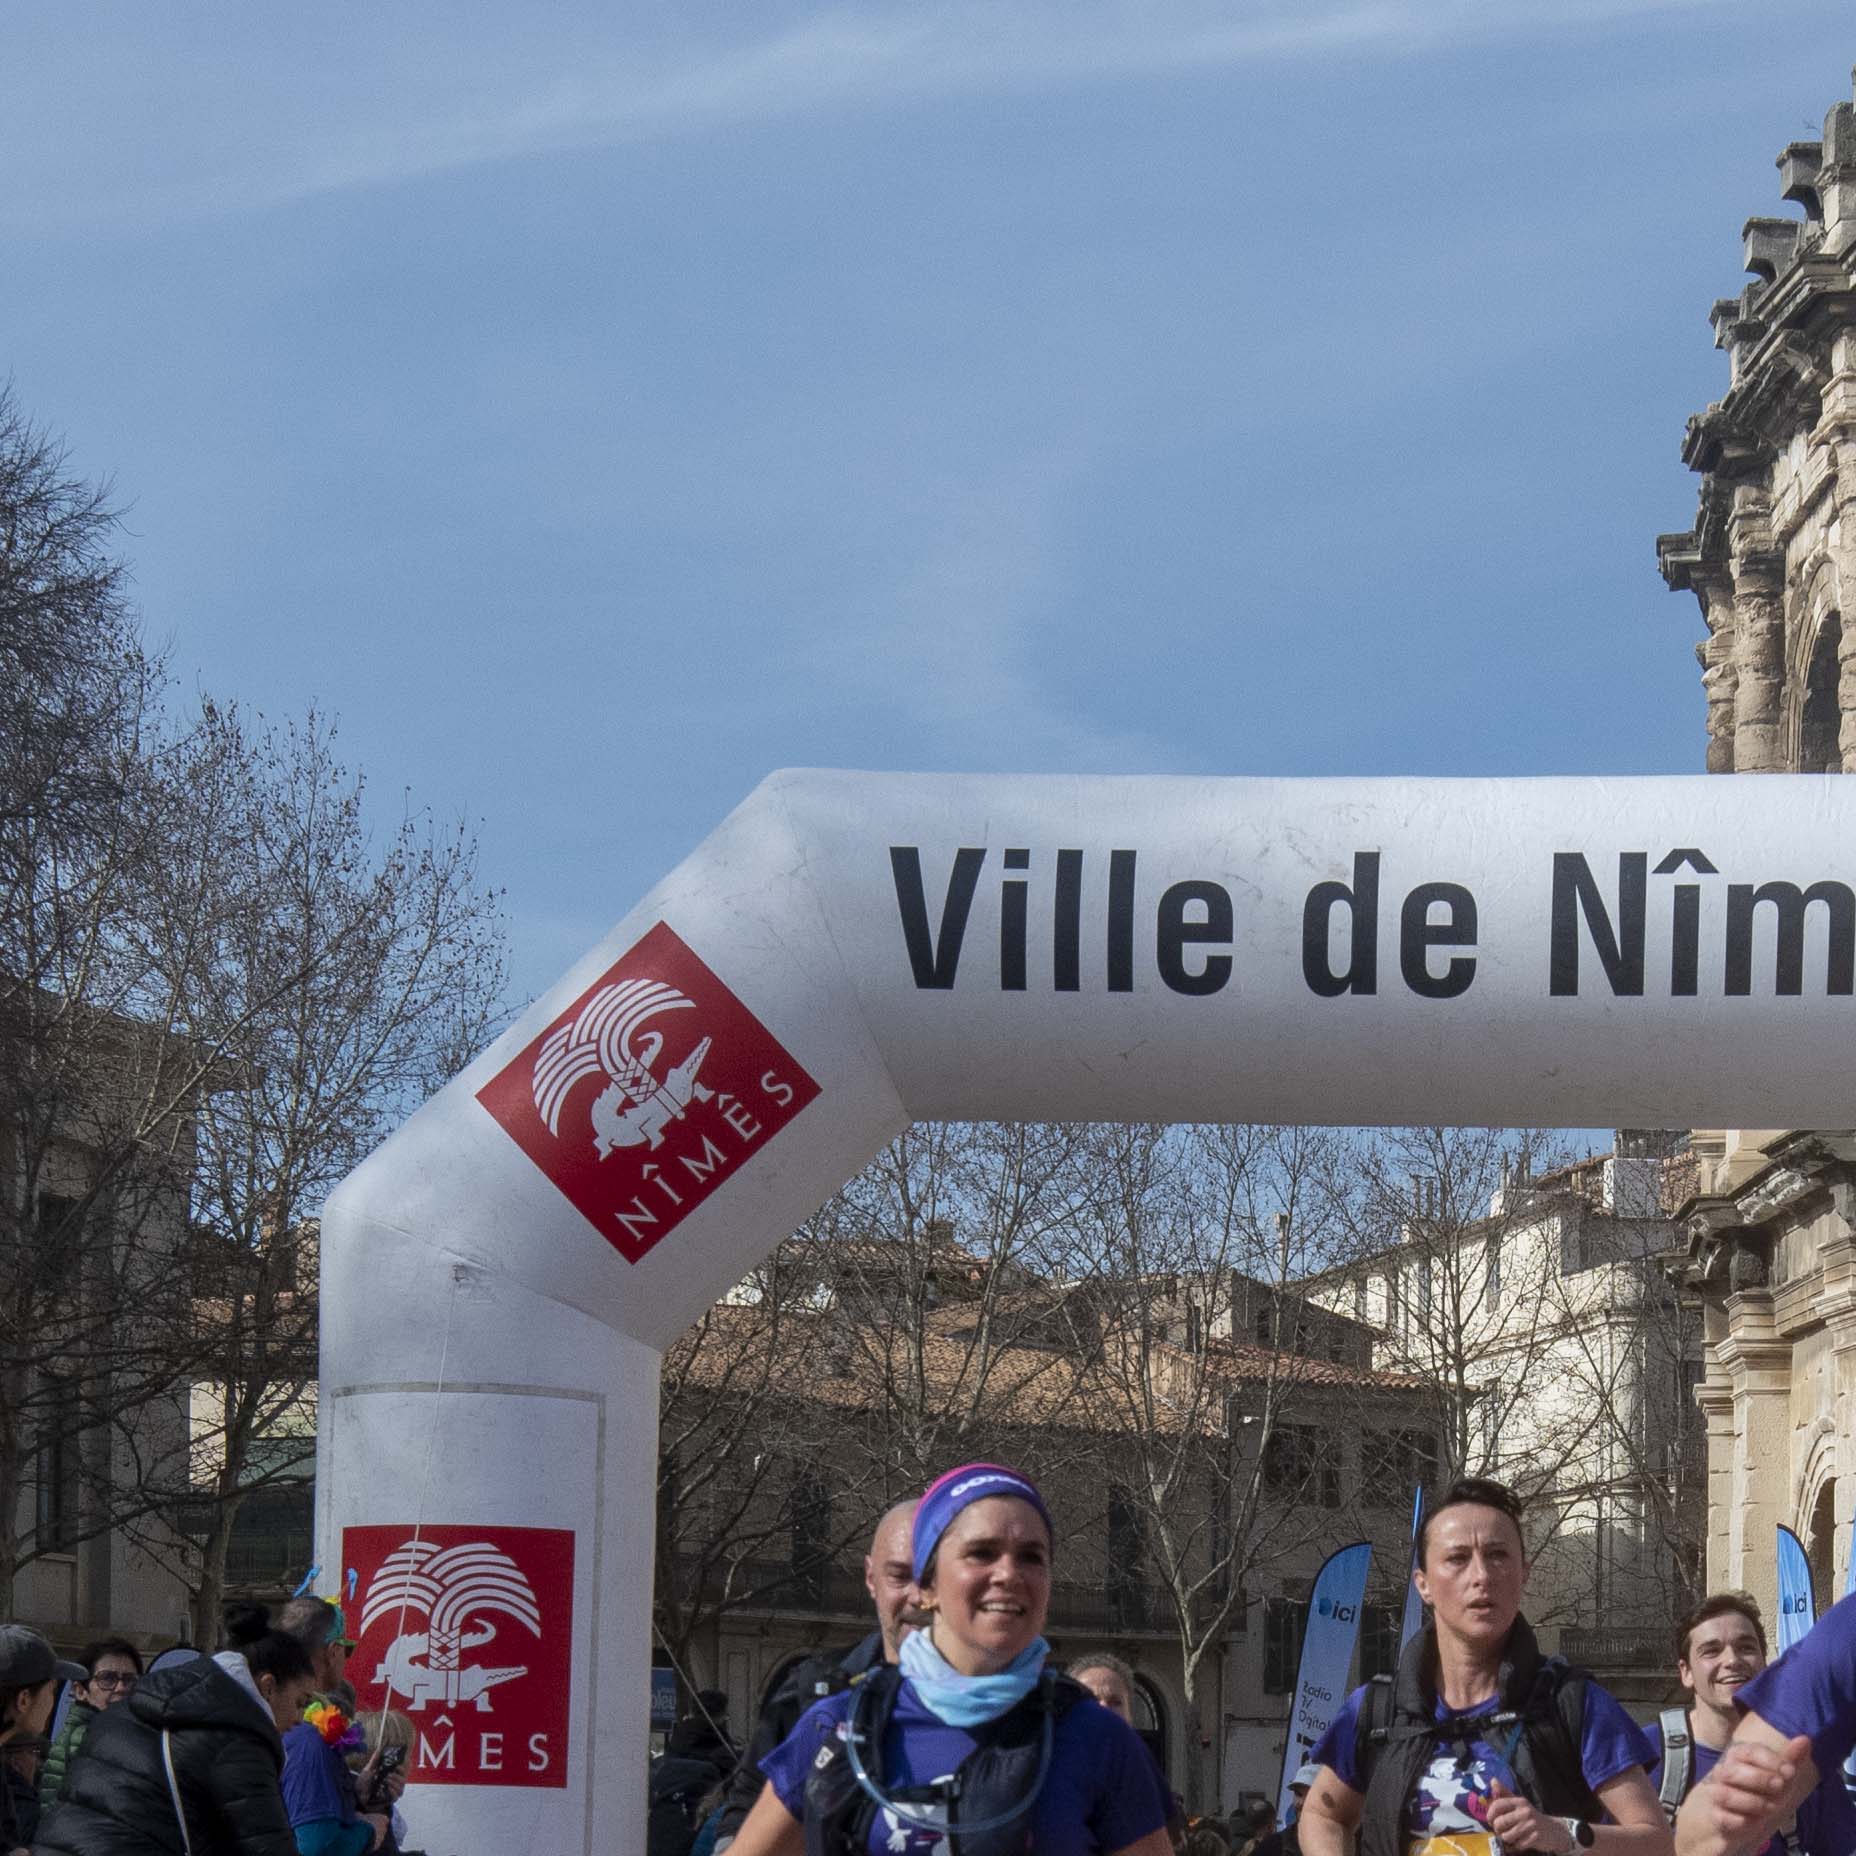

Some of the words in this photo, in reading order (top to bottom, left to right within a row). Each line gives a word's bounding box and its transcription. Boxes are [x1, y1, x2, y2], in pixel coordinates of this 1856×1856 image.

[889, 846, 1235, 997] Ville
[1303, 850, 1480, 998] de
[1331, 1600, 1358, 1625] ici
[1793, 1591, 1808, 1614] ici
